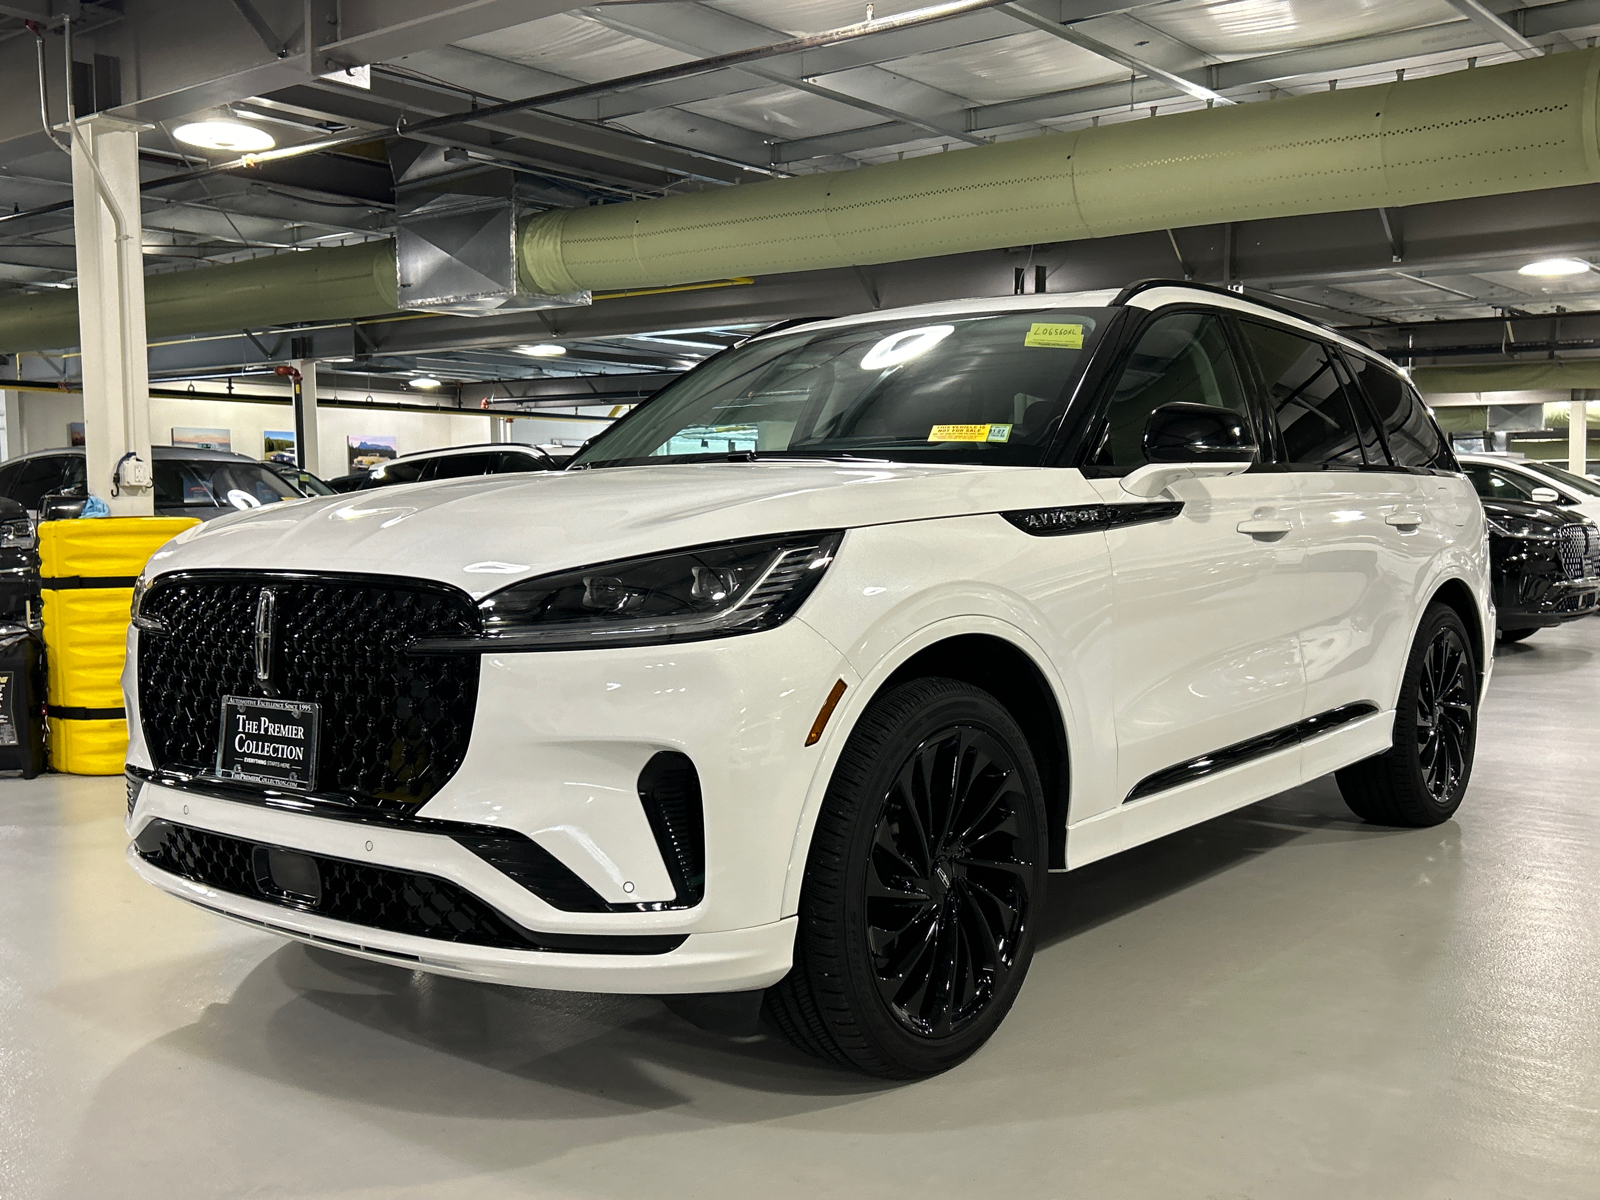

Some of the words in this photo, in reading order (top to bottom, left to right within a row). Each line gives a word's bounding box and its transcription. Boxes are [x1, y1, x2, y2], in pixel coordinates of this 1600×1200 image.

[1028, 510, 1099, 527] AVIATOR
[228, 697, 257, 706] AUTOMOTIVE
[257, 700, 284, 709] EXCELLENCE
[284, 703, 298, 711] SINCE
[236, 714, 258, 734] THE
[259, 716, 305, 740] PREMIER
[234, 733, 304, 761] COLLECTION
[243, 756, 267, 765] EVERYTHING
